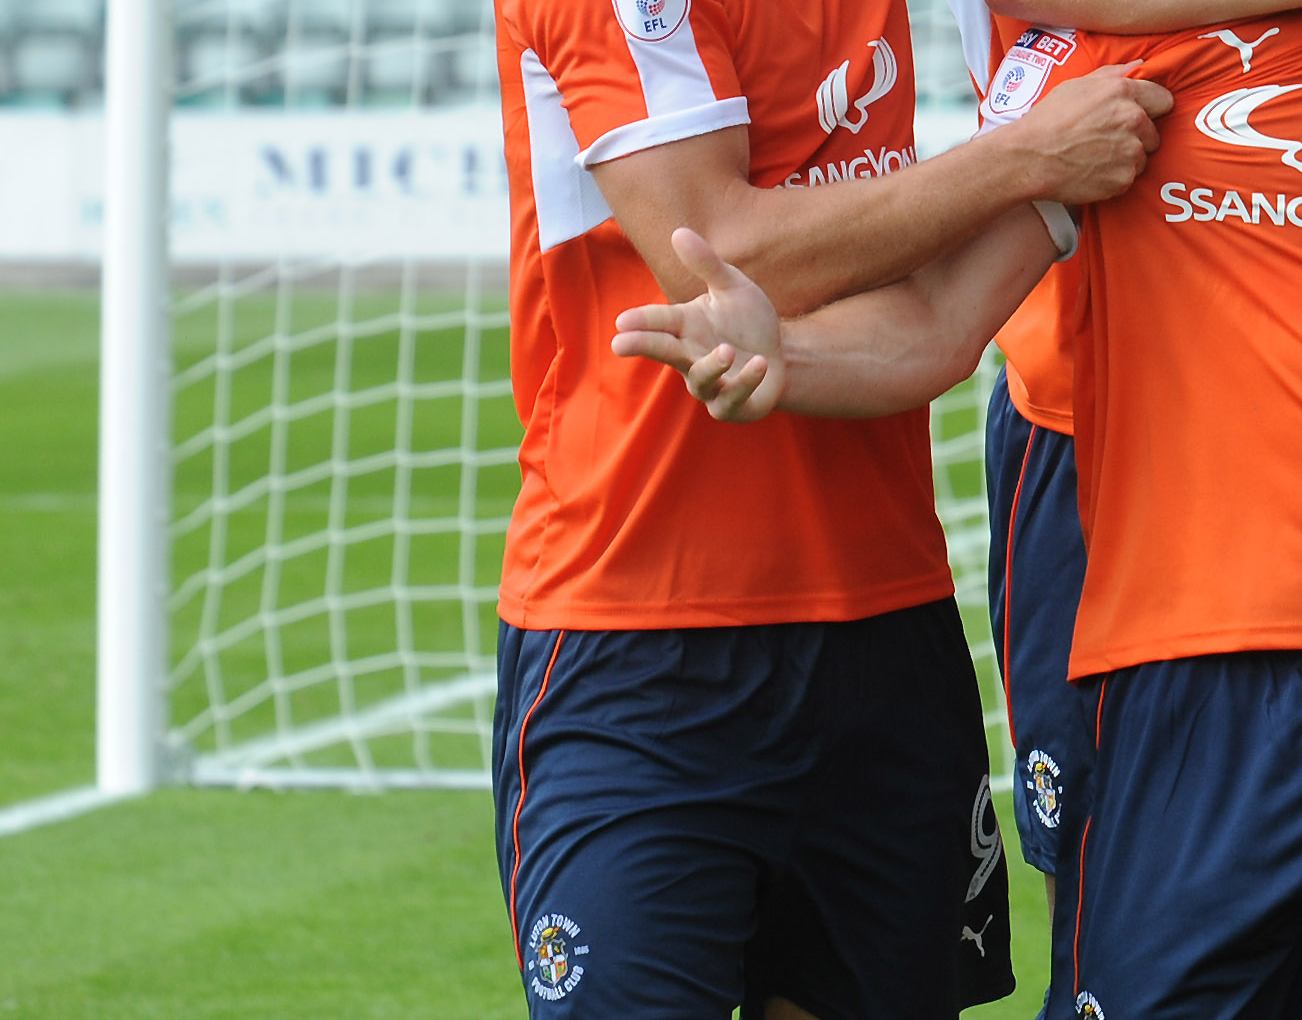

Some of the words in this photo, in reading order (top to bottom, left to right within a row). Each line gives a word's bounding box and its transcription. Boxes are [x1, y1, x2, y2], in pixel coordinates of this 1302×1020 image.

[643, 17, 668, 33] EFL
[1036, 35, 1069, 56] BET
[964, 773, 1001, 903] 9
[550, 913, 582, 939] TOWN
